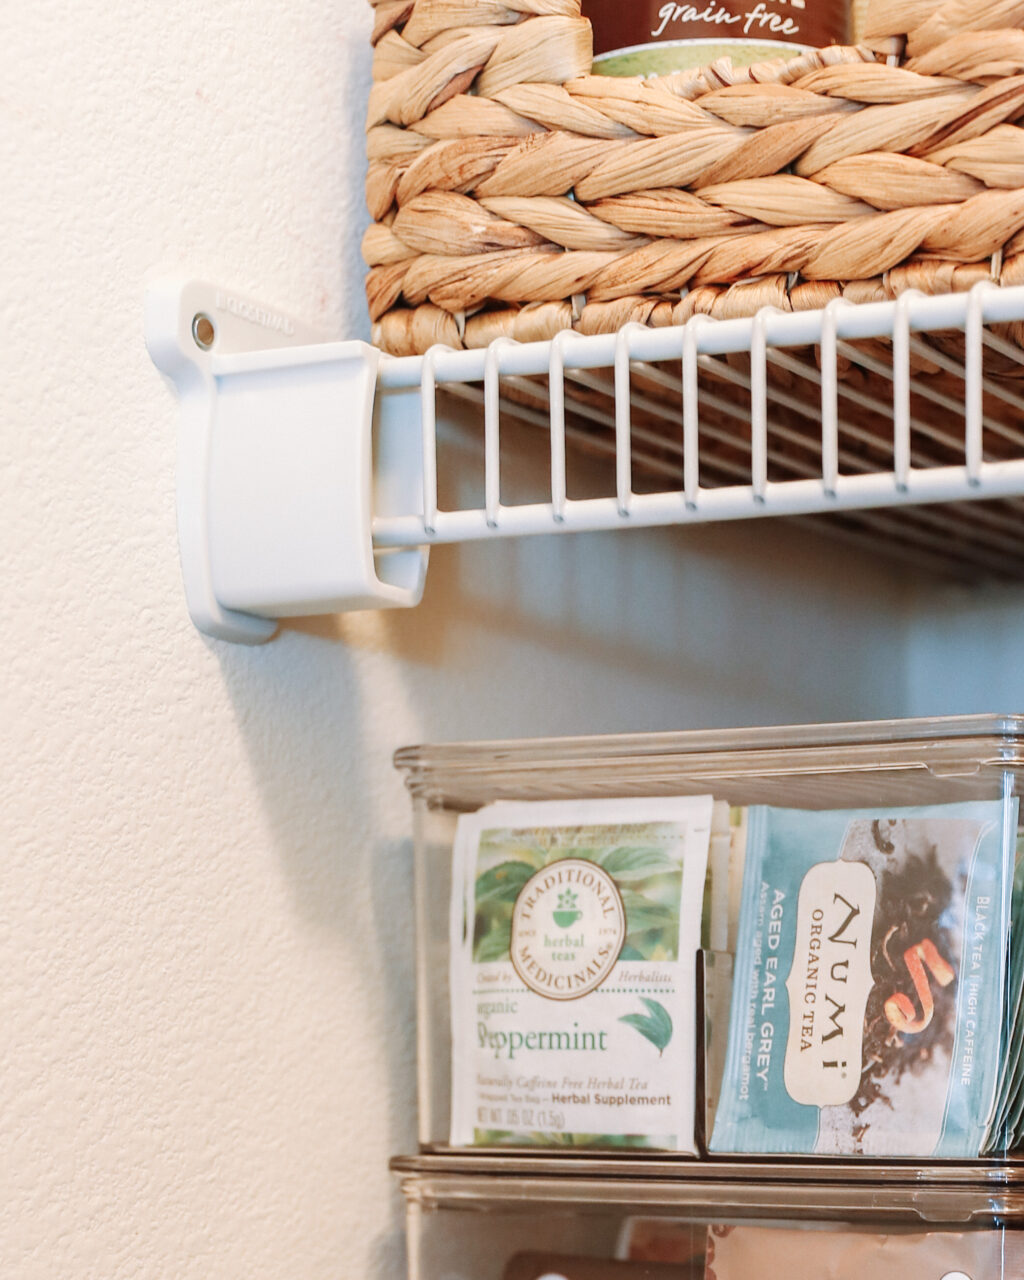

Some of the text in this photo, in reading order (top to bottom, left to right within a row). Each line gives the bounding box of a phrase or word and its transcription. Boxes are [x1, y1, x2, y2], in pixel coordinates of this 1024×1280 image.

[651, 1, 800, 37] grain free
[521, 868, 615, 920] TRADITIONAL
[544, 933, 585, 947] herbal
[552, 952, 576, 961] teas
[520, 944, 609, 990] MEDICINALS
[619, 970, 673, 983] Herbalists
[756, 889, 786, 1083] AGED EARL GREY
[800, 908, 824, 1053] ORGANIC TEA
[960, 896, 991, 1087] BLACK TEA HIGH CAFFEINE
[561, 1075, 583, 1089] Free
[587, 1075, 624, 1090] Herbal
[629, 1076, 648, 1090] Tea
[738, 1032, 756, 1101] bergamot
[551, 1092, 590, 1105] Herbal
[594, 1093, 671, 1107] Supplement
